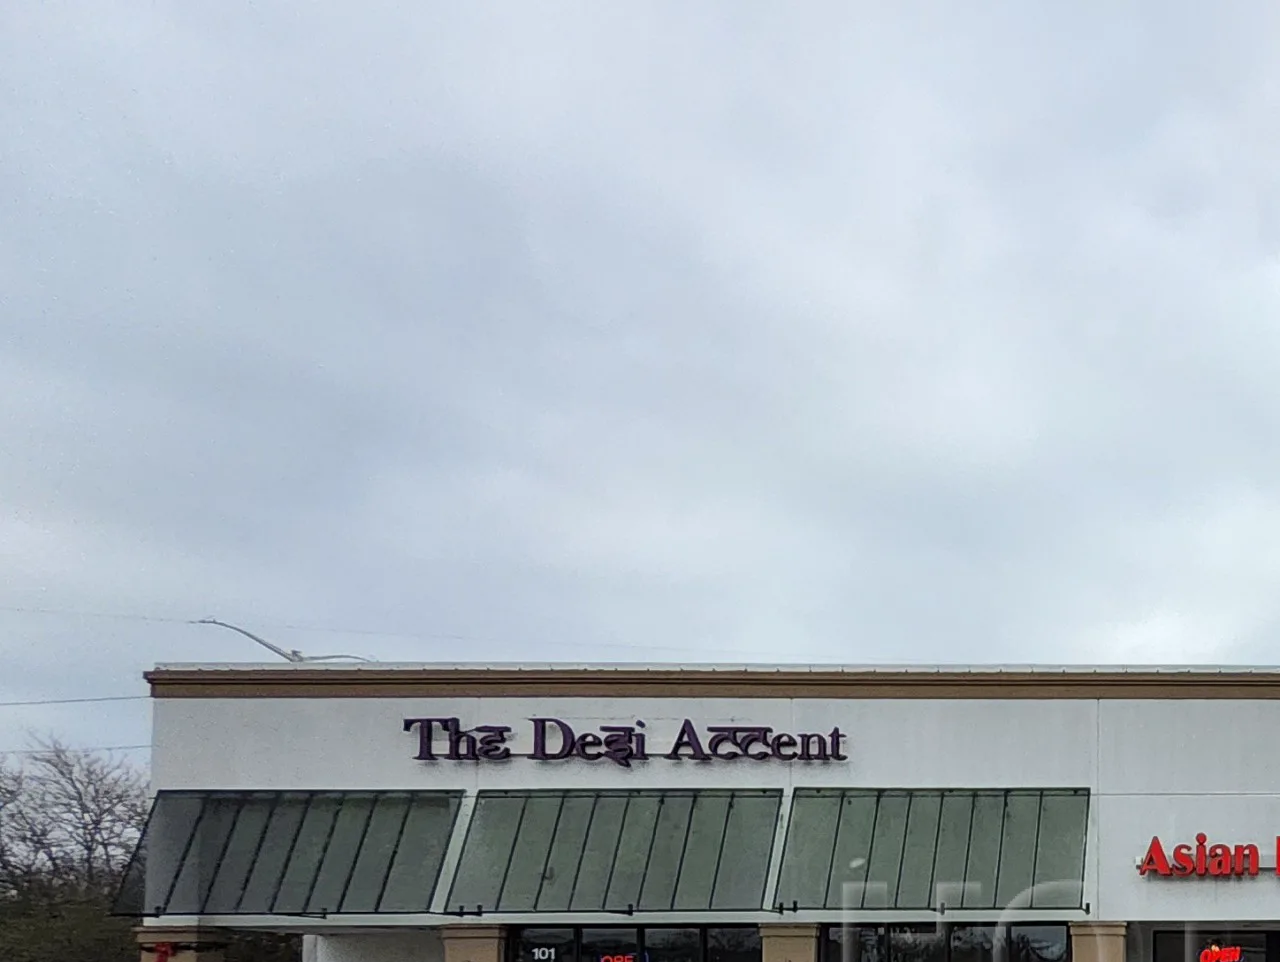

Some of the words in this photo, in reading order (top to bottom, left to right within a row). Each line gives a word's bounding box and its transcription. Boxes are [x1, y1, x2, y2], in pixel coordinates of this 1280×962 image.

[403, 717, 511, 761] The
[664, 718, 848, 762] Accent
[1139, 832, 1260, 877] Asian
[532, 947, 556, 960] 101
